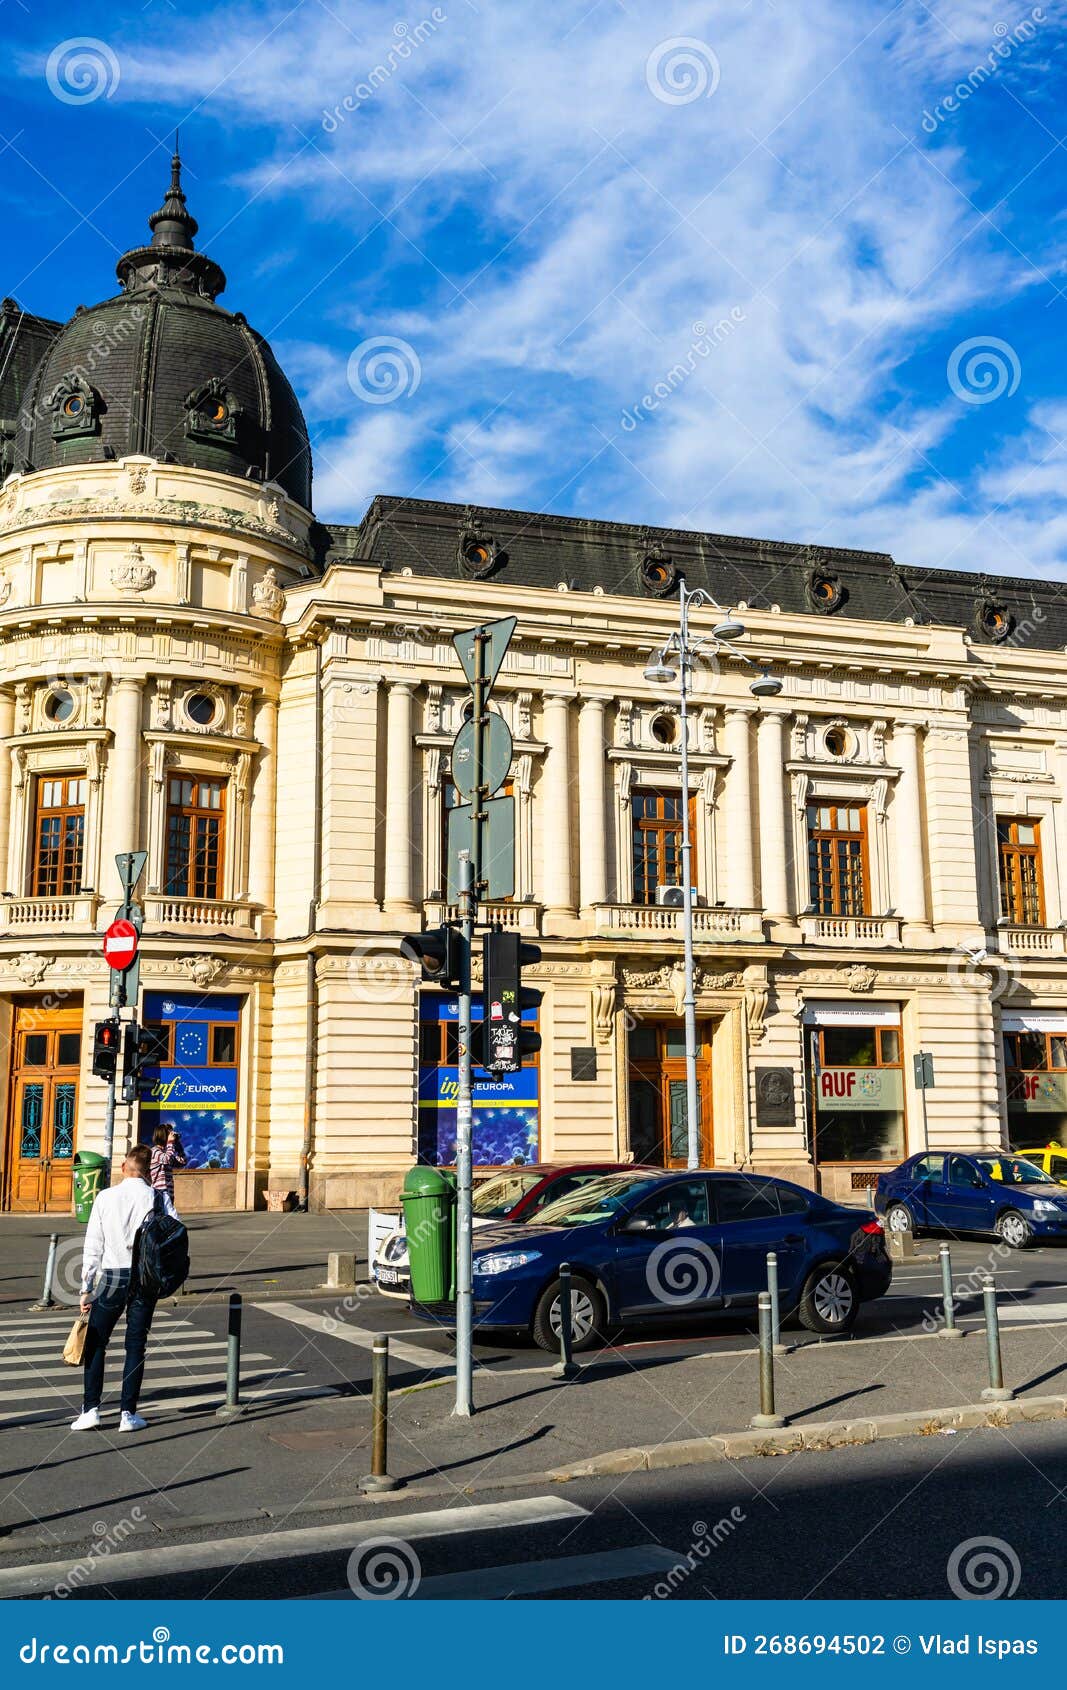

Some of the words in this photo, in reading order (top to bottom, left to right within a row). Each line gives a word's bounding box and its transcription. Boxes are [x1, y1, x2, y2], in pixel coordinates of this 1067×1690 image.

[477, 1083, 514, 1091] EUROPA
[821, 1072, 856, 1097] AUF
[188, 1085, 227, 1093] EUROPA
